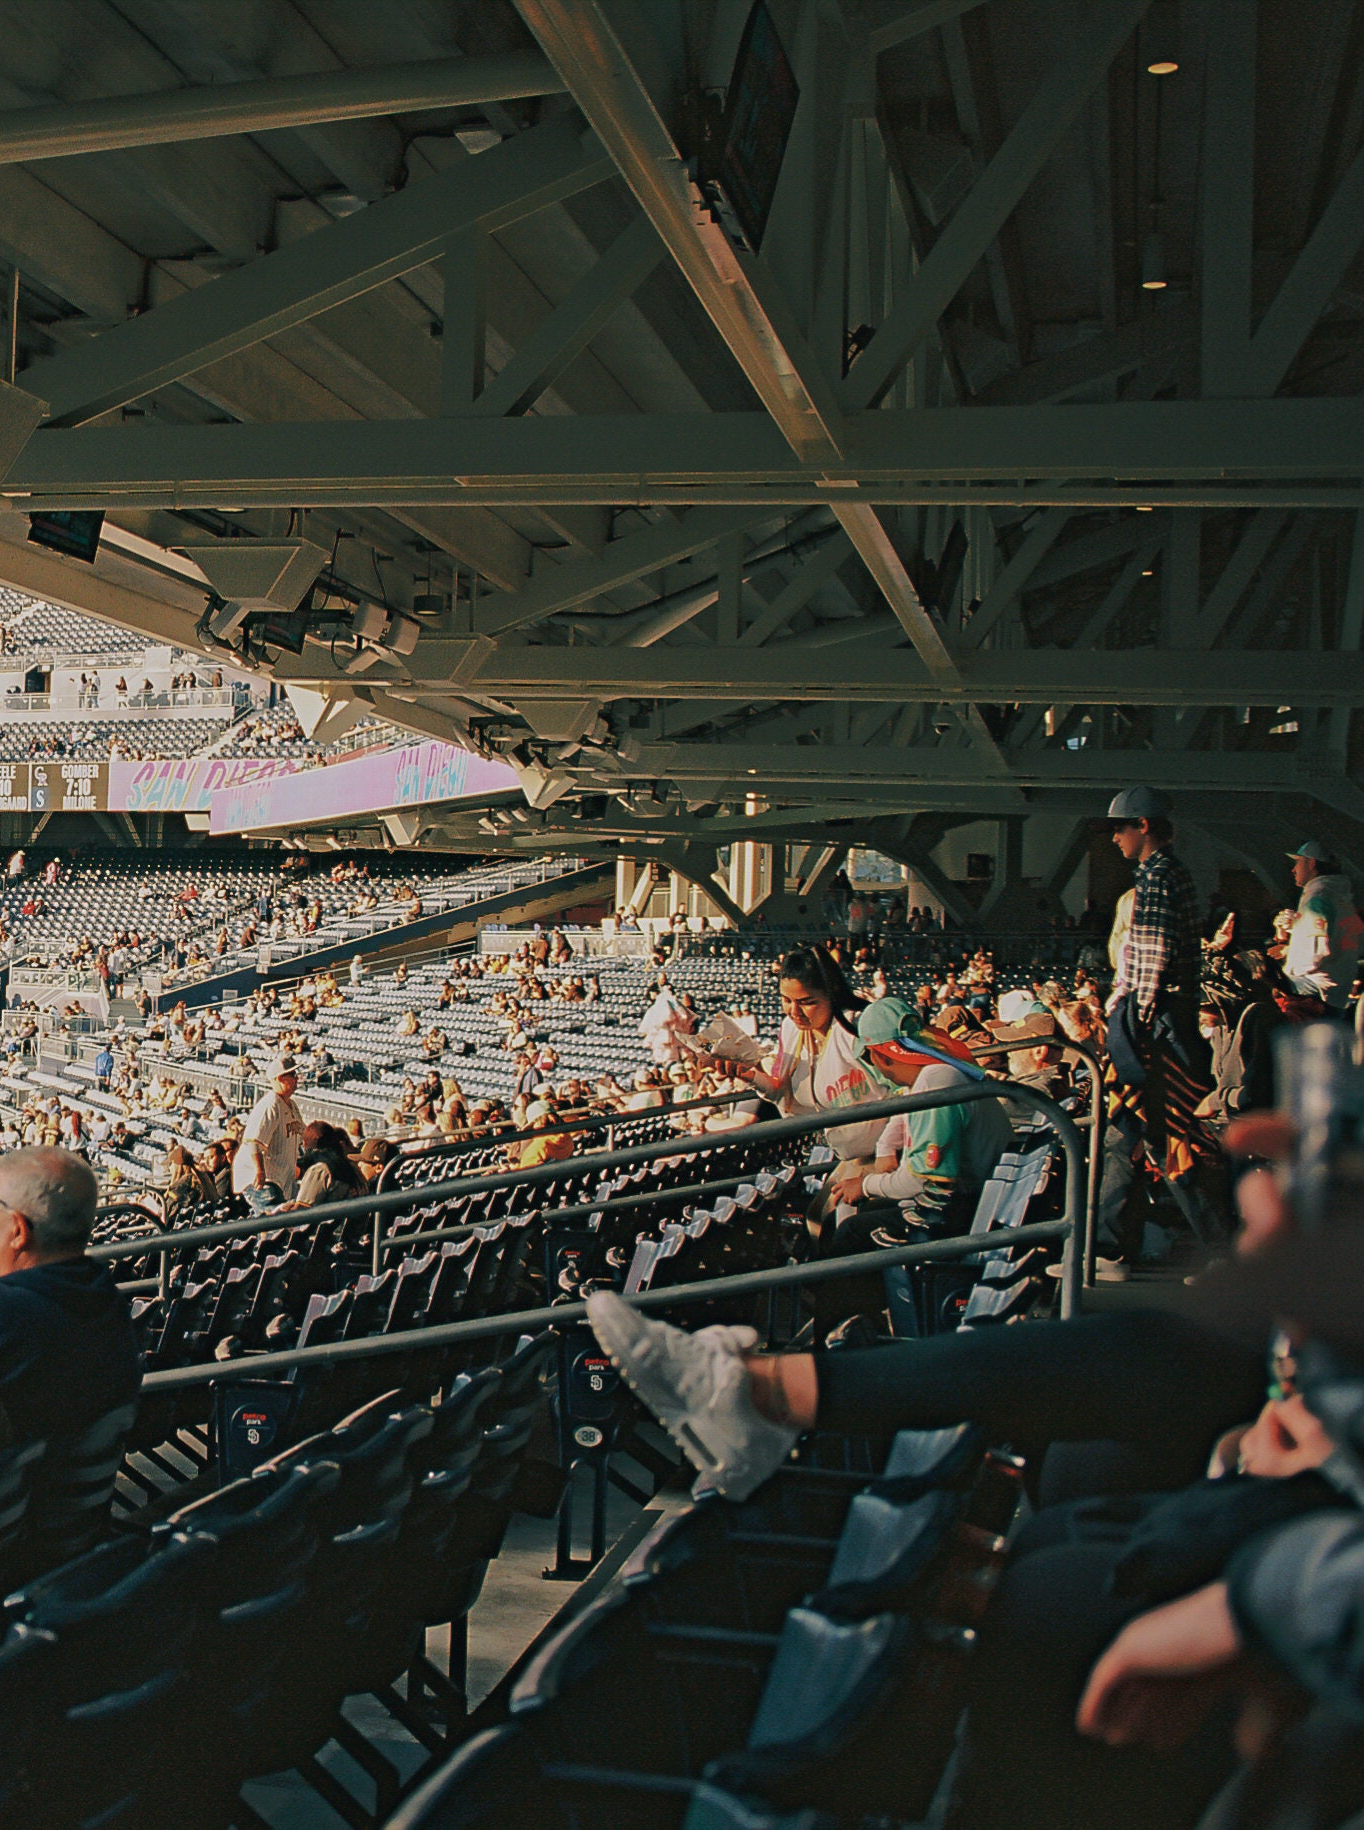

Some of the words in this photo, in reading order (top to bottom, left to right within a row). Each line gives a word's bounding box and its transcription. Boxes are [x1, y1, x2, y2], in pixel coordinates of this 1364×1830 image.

[61, 764, 99, 779] GOMBER
[66, 778, 91, 796] 7:10
[128, 762, 199, 809] SAN
[62, 796, 97, 811] MILONE
[826, 1069, 871, 1108] DIEGO
[585, 1358, 610, 1367] petco
[581, 1430, 596, 1442] 38
